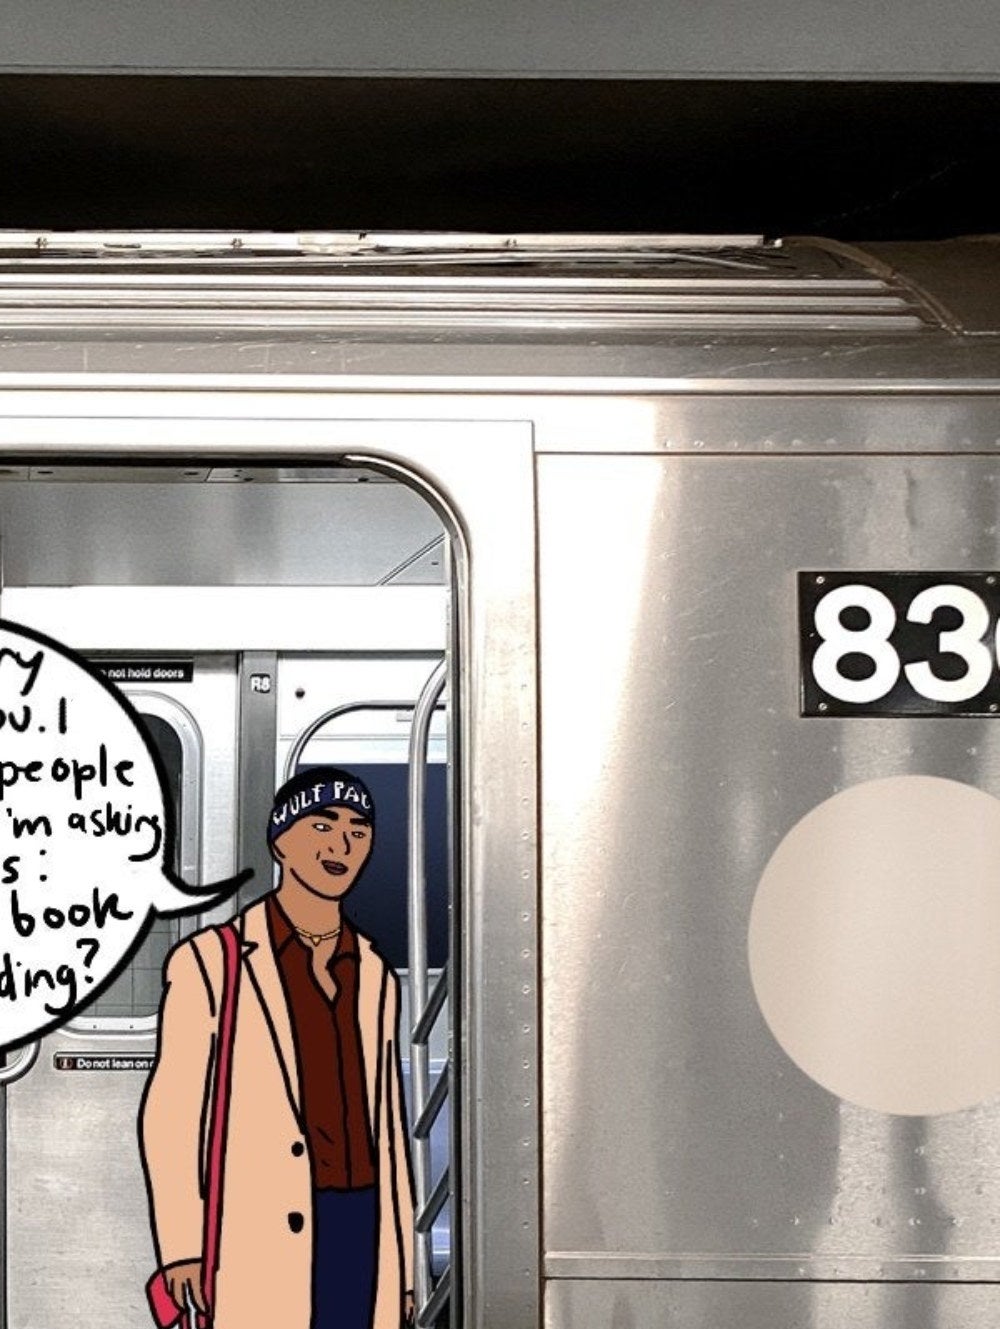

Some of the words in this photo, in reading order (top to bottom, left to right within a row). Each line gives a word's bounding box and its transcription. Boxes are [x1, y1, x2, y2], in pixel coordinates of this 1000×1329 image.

[811, 584, 1000, 703] 83
[127, 667, 152, 679] hold
[153, 667, 184, 680] doors
[77, 1058, 93, 1069] Do
[93, 1059, 111, 1069] not
[112, 1058, 134, 1069] lean
